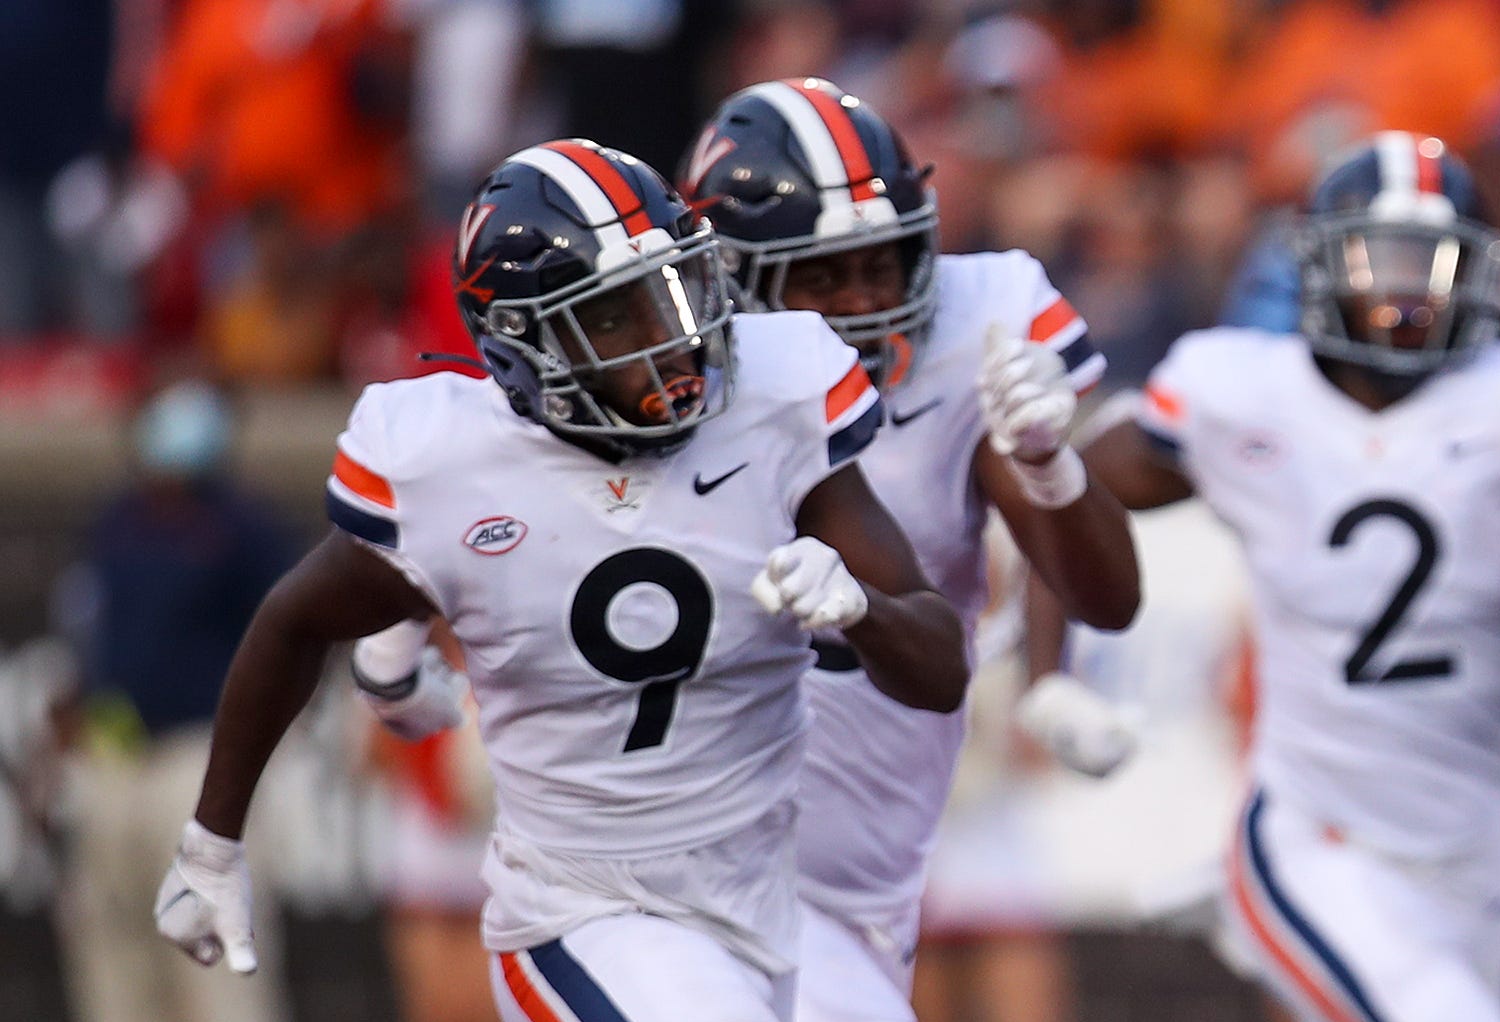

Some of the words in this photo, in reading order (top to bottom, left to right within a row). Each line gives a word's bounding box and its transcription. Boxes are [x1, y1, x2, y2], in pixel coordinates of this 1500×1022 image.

[471, 520, 516, 549] ACC
[606, 477, 629, 501] V
[1328, 498, 1455, 684] 2
[569, 546, 713, 754] 9
